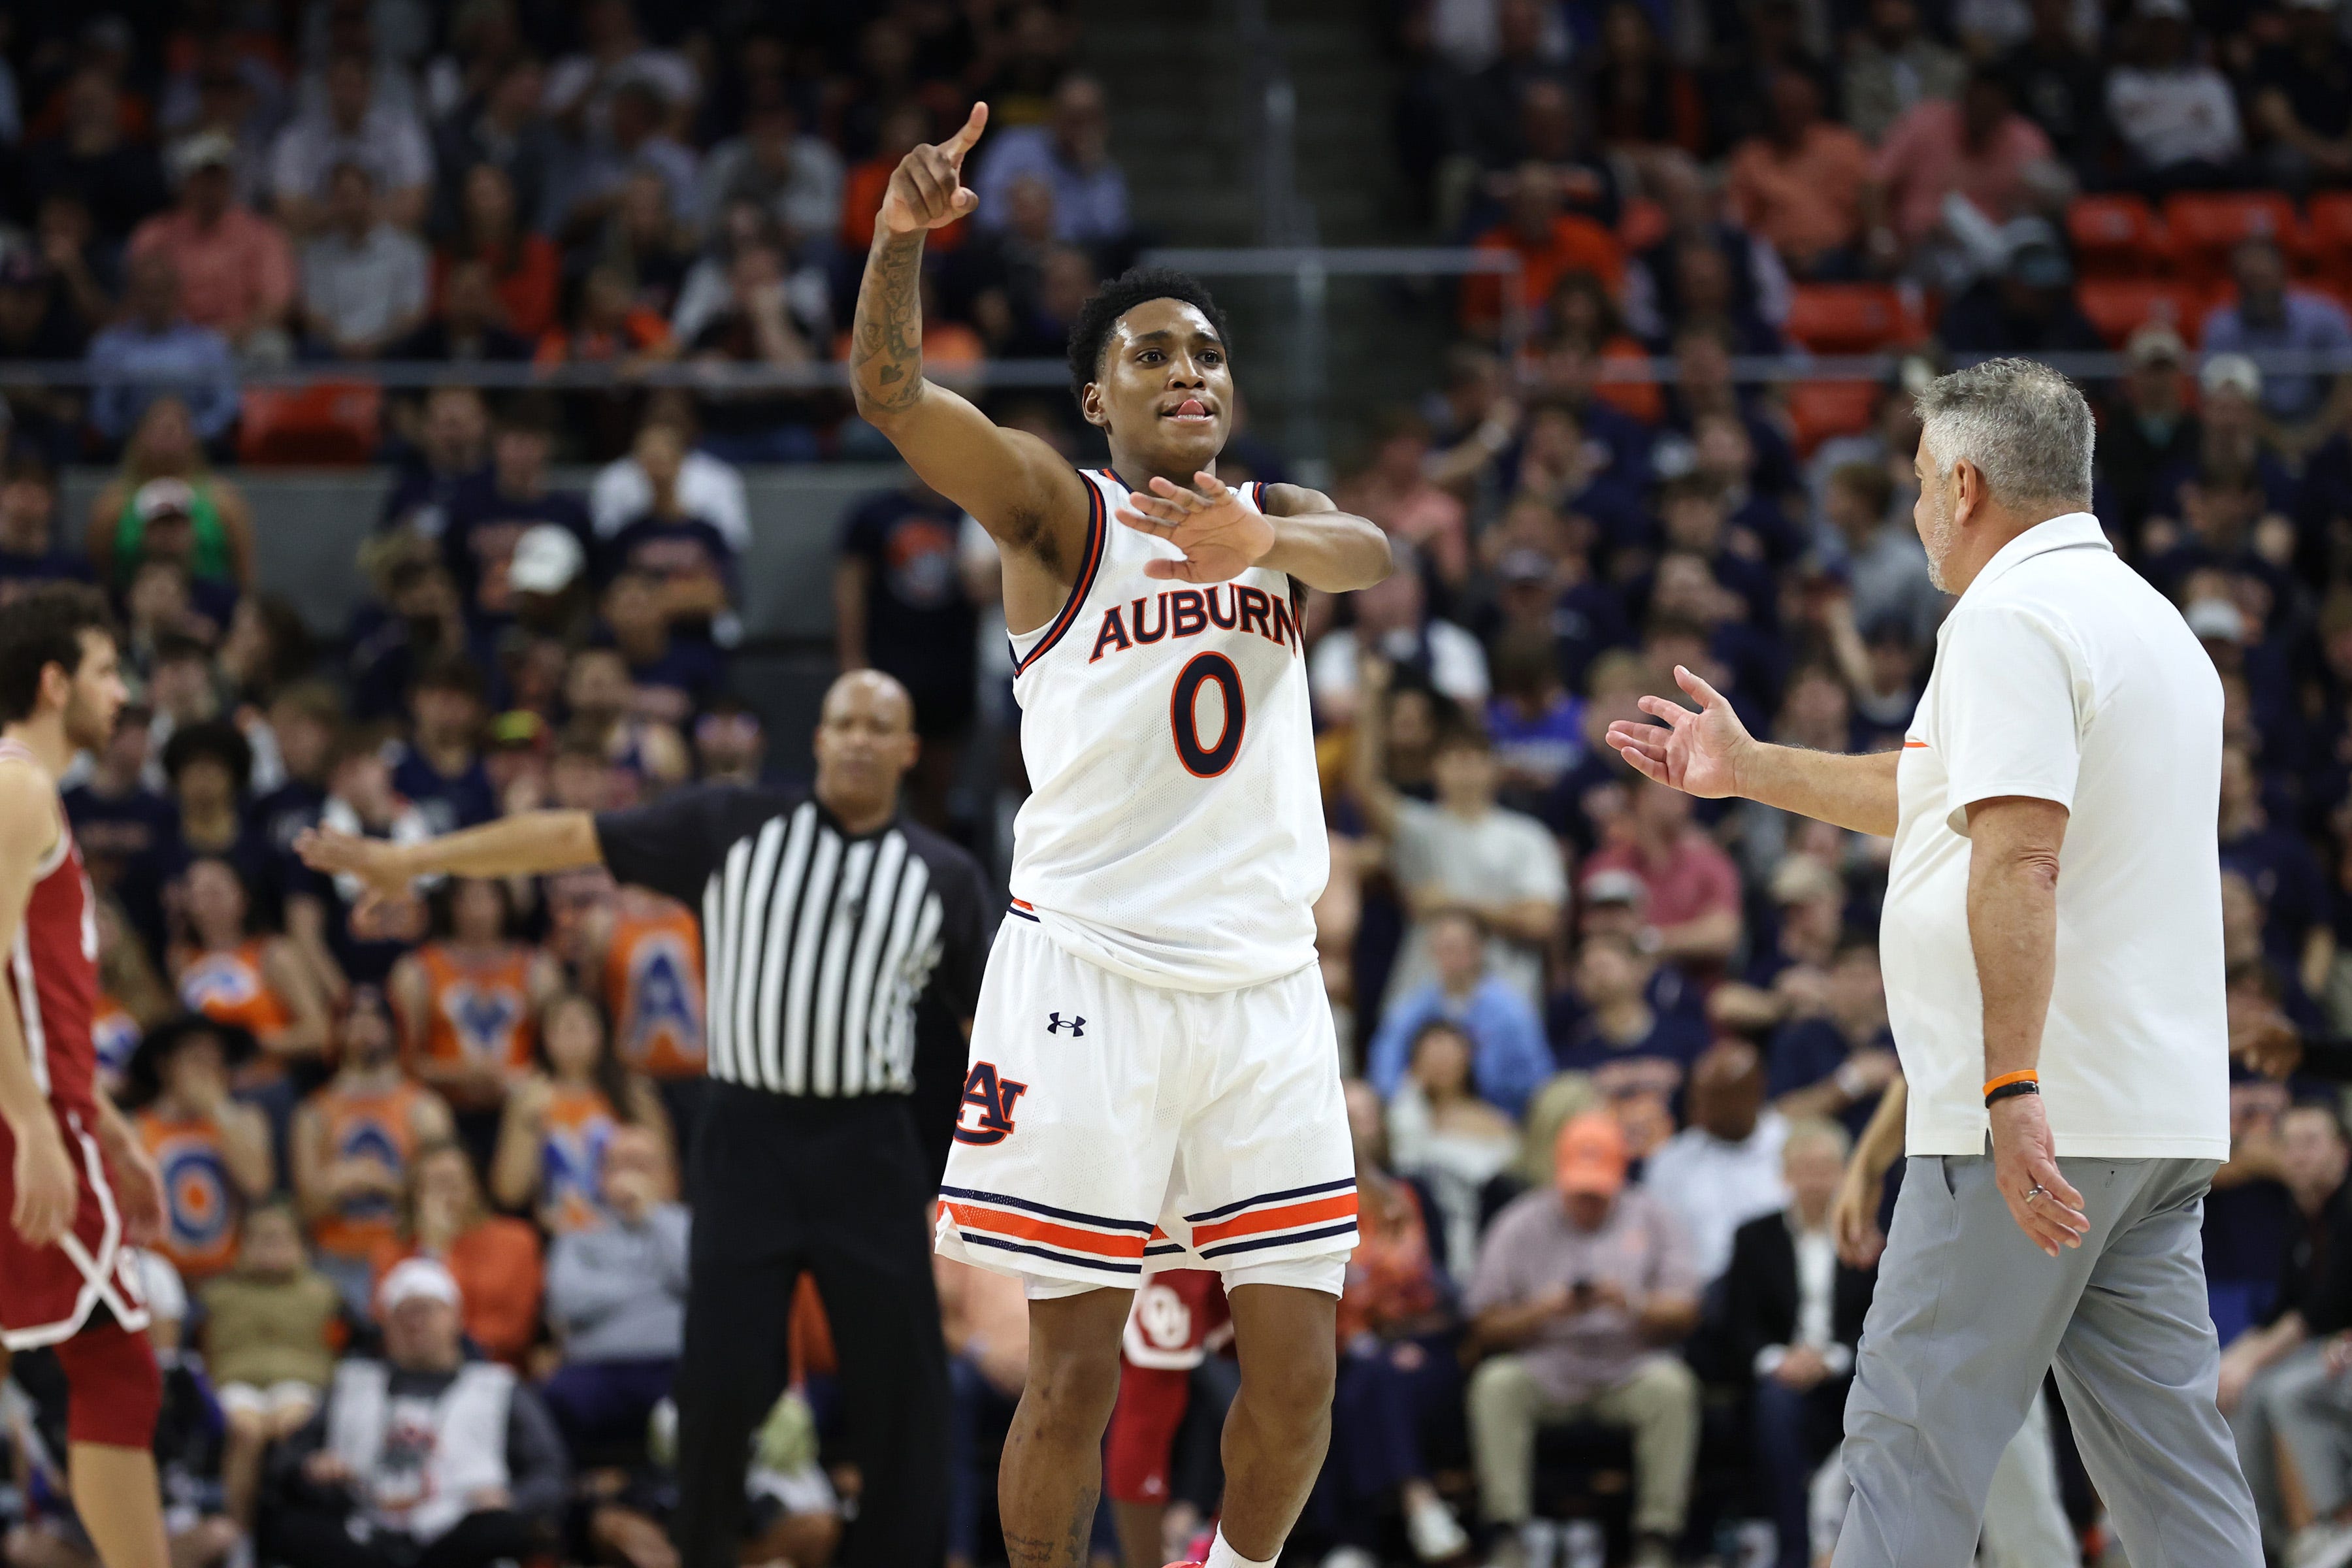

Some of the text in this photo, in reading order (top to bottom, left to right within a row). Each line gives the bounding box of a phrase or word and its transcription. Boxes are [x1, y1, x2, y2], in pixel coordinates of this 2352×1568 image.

[1089, 582, 1298, 659] AUBURN
[1170, 650, 1247, 779] 0
[953, 1060, 1028, 1147] AU
[1141, 1284, 1192, 1348] OU
